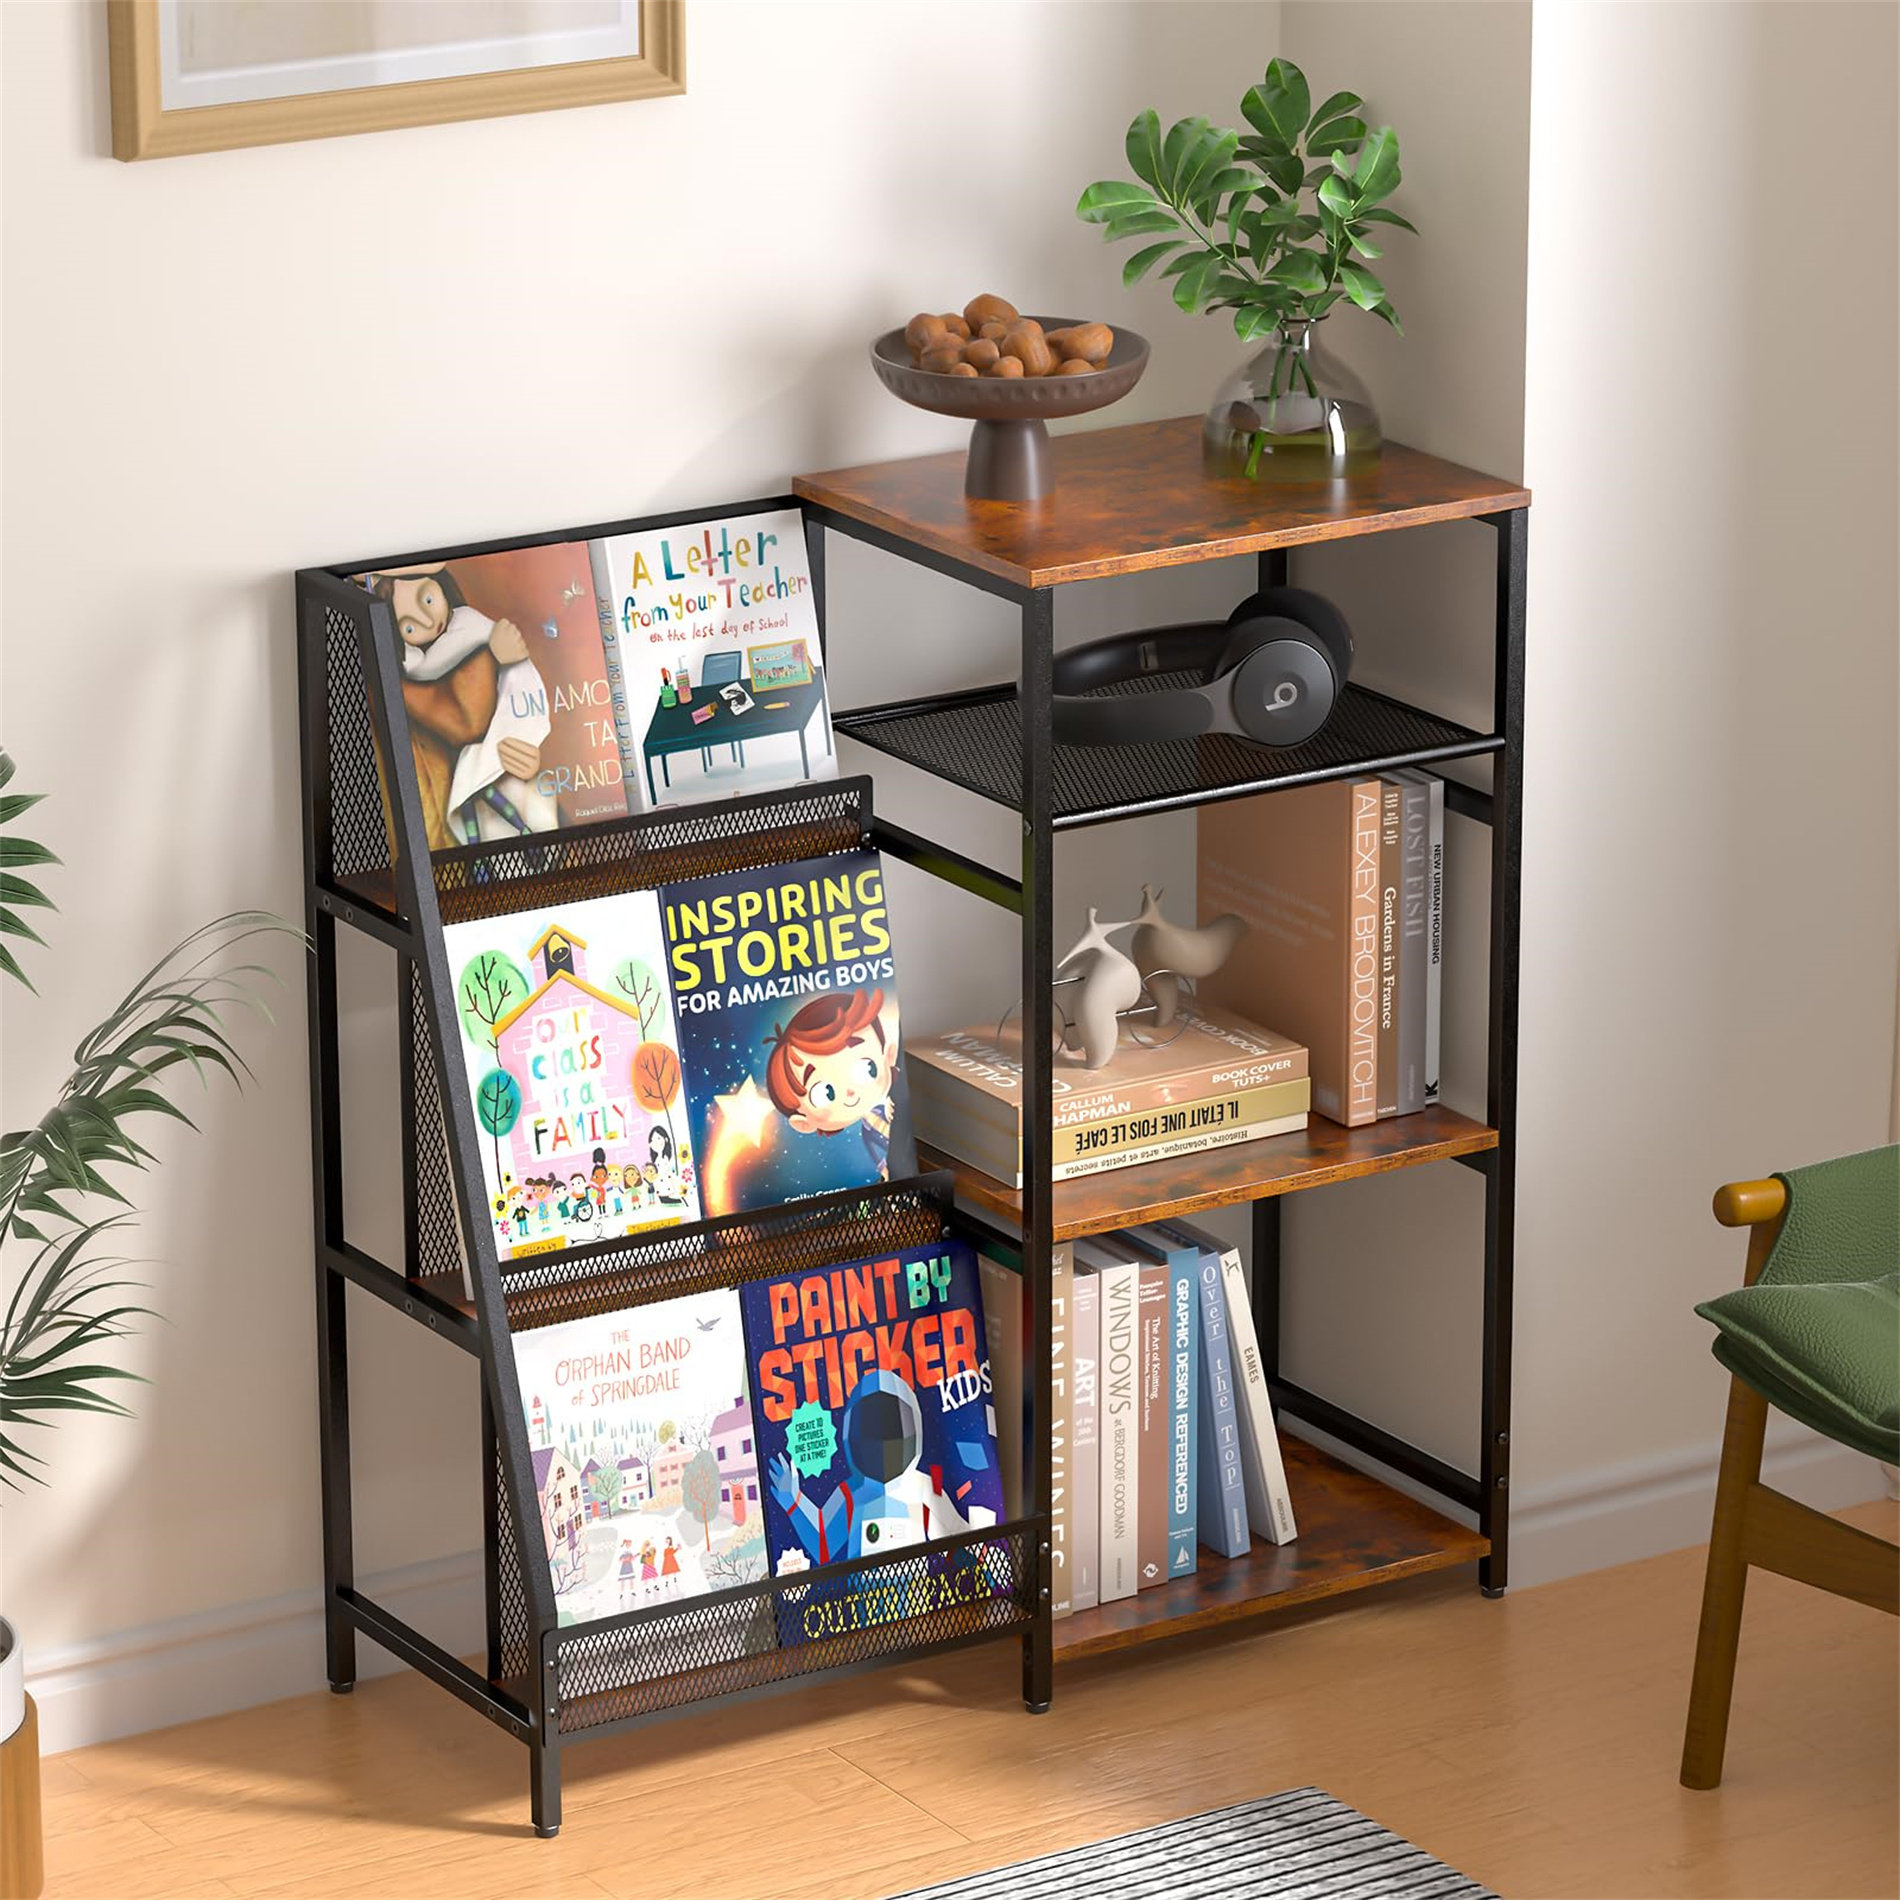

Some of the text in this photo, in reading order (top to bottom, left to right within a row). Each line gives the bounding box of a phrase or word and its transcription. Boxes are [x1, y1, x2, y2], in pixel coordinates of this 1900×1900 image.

[632, 527, 778, 589] A Letter
[621, 596, 669, 634] from
[717, 565, 808, 609] Teacher
[650, 613, 789, 644] on the last day of School
[510, 679, 611, 718] UN AMO
[583, 719, 618, 748] TA
[536, 758, 623, 797] GRAND
[1355, 793, 1377, 904] ALEXEY
[1405, 797, 1425, 937] LOST FISH
[666, 869, 883, 941] INSPIRING
[1432, 844, 1442, 964] NEW URBAN HOUSING
[672, 908, 891, 991] STORIES
[1382, 887, 1397, 1029] Gardens in France
[677, 958, 894, 1018] FOR AMAZING BOYS
[1352, 914, 1376, 1104] BRODOVITCH
[580, 1081, 594, 1104] a
[1211, 1059, 1292, 1083] BOOK COVER
[1232, 1074, 1271, 1089] TUTS+
[534, 1103, 627, 1155] FAMILY
[1052, 1101, 1131, 1127] HAPMAN
[1059, 1094, 1114, 1113] CALLUM
[1075, 1100, 1239, 1155] IL ÉTAIT UNE FOIS LE CAFÉ
[769, 1255, 952, 1345] PAINT BY
[1176, 1278, 1189, 1349] GRAPHIC
[555, 1337, 691, 1386] ORPHAN BAND
[611, 1330, 631, 1344] THE
[1109, 1276, 1131, 1415] WINDOWS
[1150, 1316, 1161, 1400] The Art of Knitting
[1203, 1266, 1220, 1336] Over
[1215, 1358, 1228, 1408] the
[571, 1368, 680, 1407] of SPRINGDALE
[759, 1308, 980, 1423] STICKER
[936, 1360, 992, 1413] KIDS
[1075, 1357, 1096, 1407] ART
[1176, 1352, 1189, 1410] DESIGN
[1244, 1347, 1258, 1384] EAMES
[1114, 1428, 1126, 1482] BERGDORF
[1175, 1413, 1189, 1515] REFERENCED
[1114, 1484, 1126, 1540] GOODMAN
